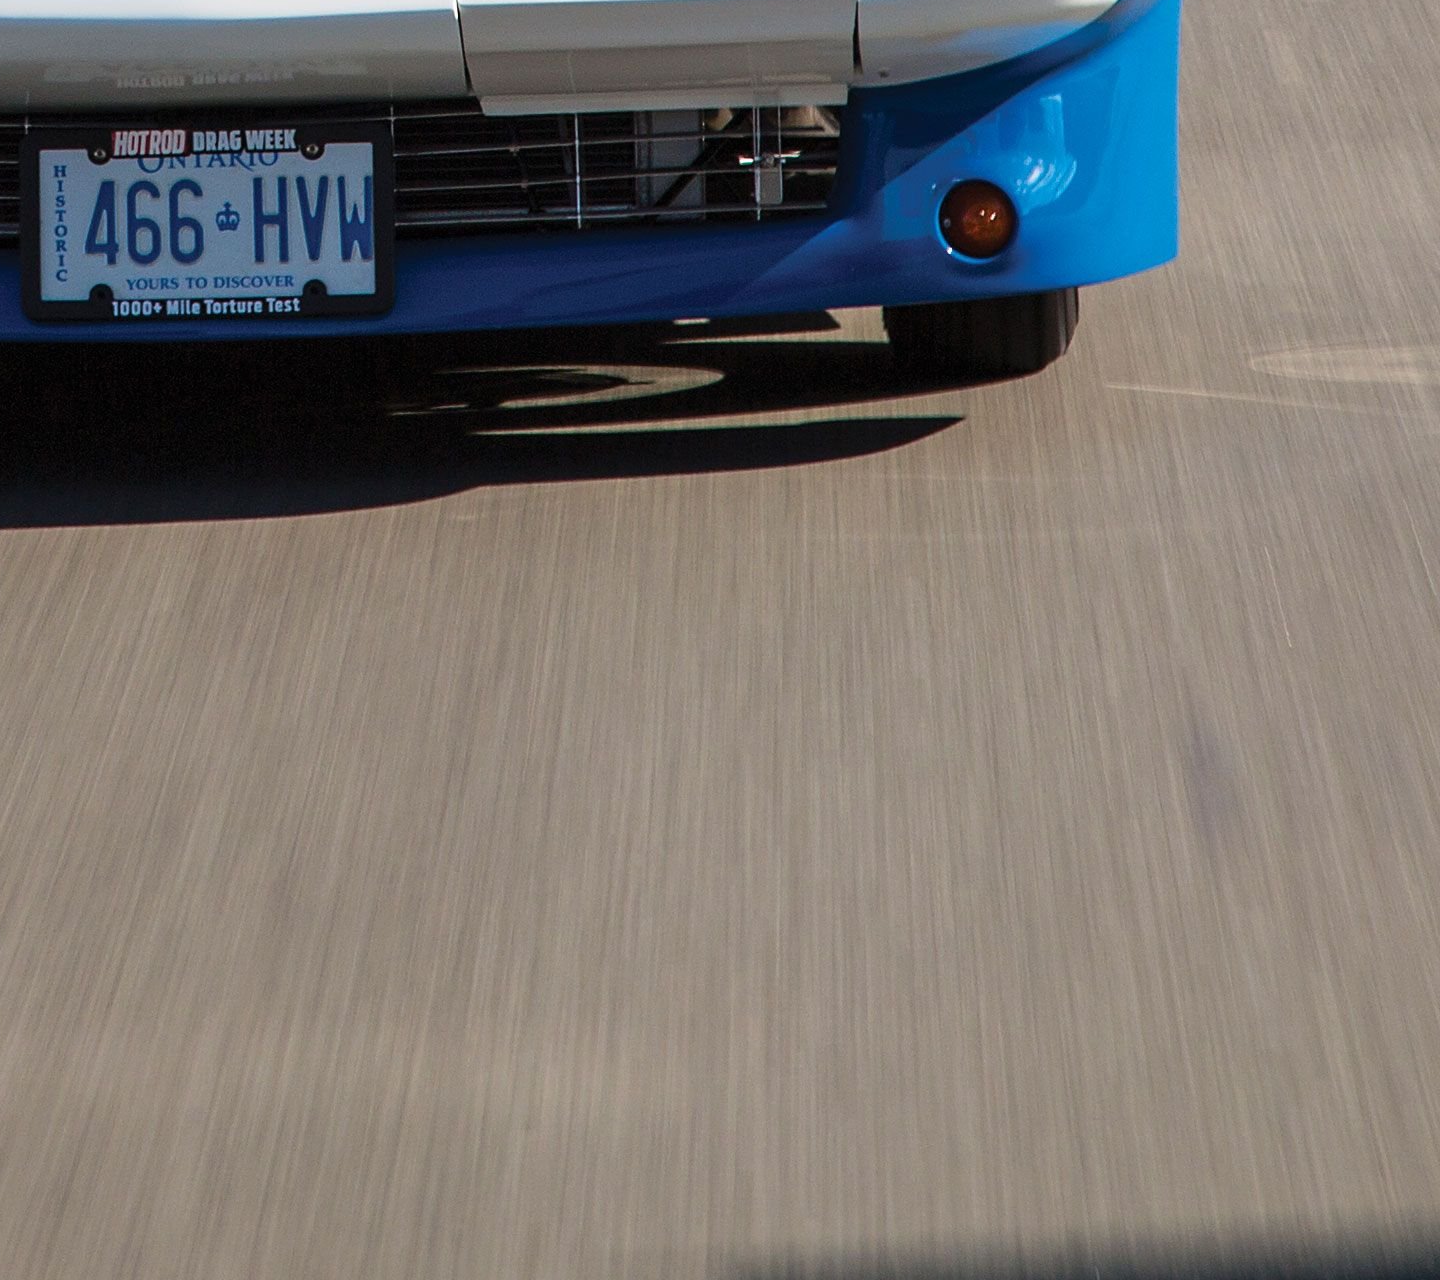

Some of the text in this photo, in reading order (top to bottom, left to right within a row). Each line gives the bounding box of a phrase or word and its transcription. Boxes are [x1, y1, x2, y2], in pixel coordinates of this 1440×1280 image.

[192, 130, 241, 152] DRAG
[245, 128, 297, 152] WEEK
[52, 164, 68, 282] HISTORIC
[84, 178, 205, 266] 466
[126, 275, 294, 291] YOURS TO DISCOVER
[112, 297, 301, 317] 1000+ Mile Torture Test
